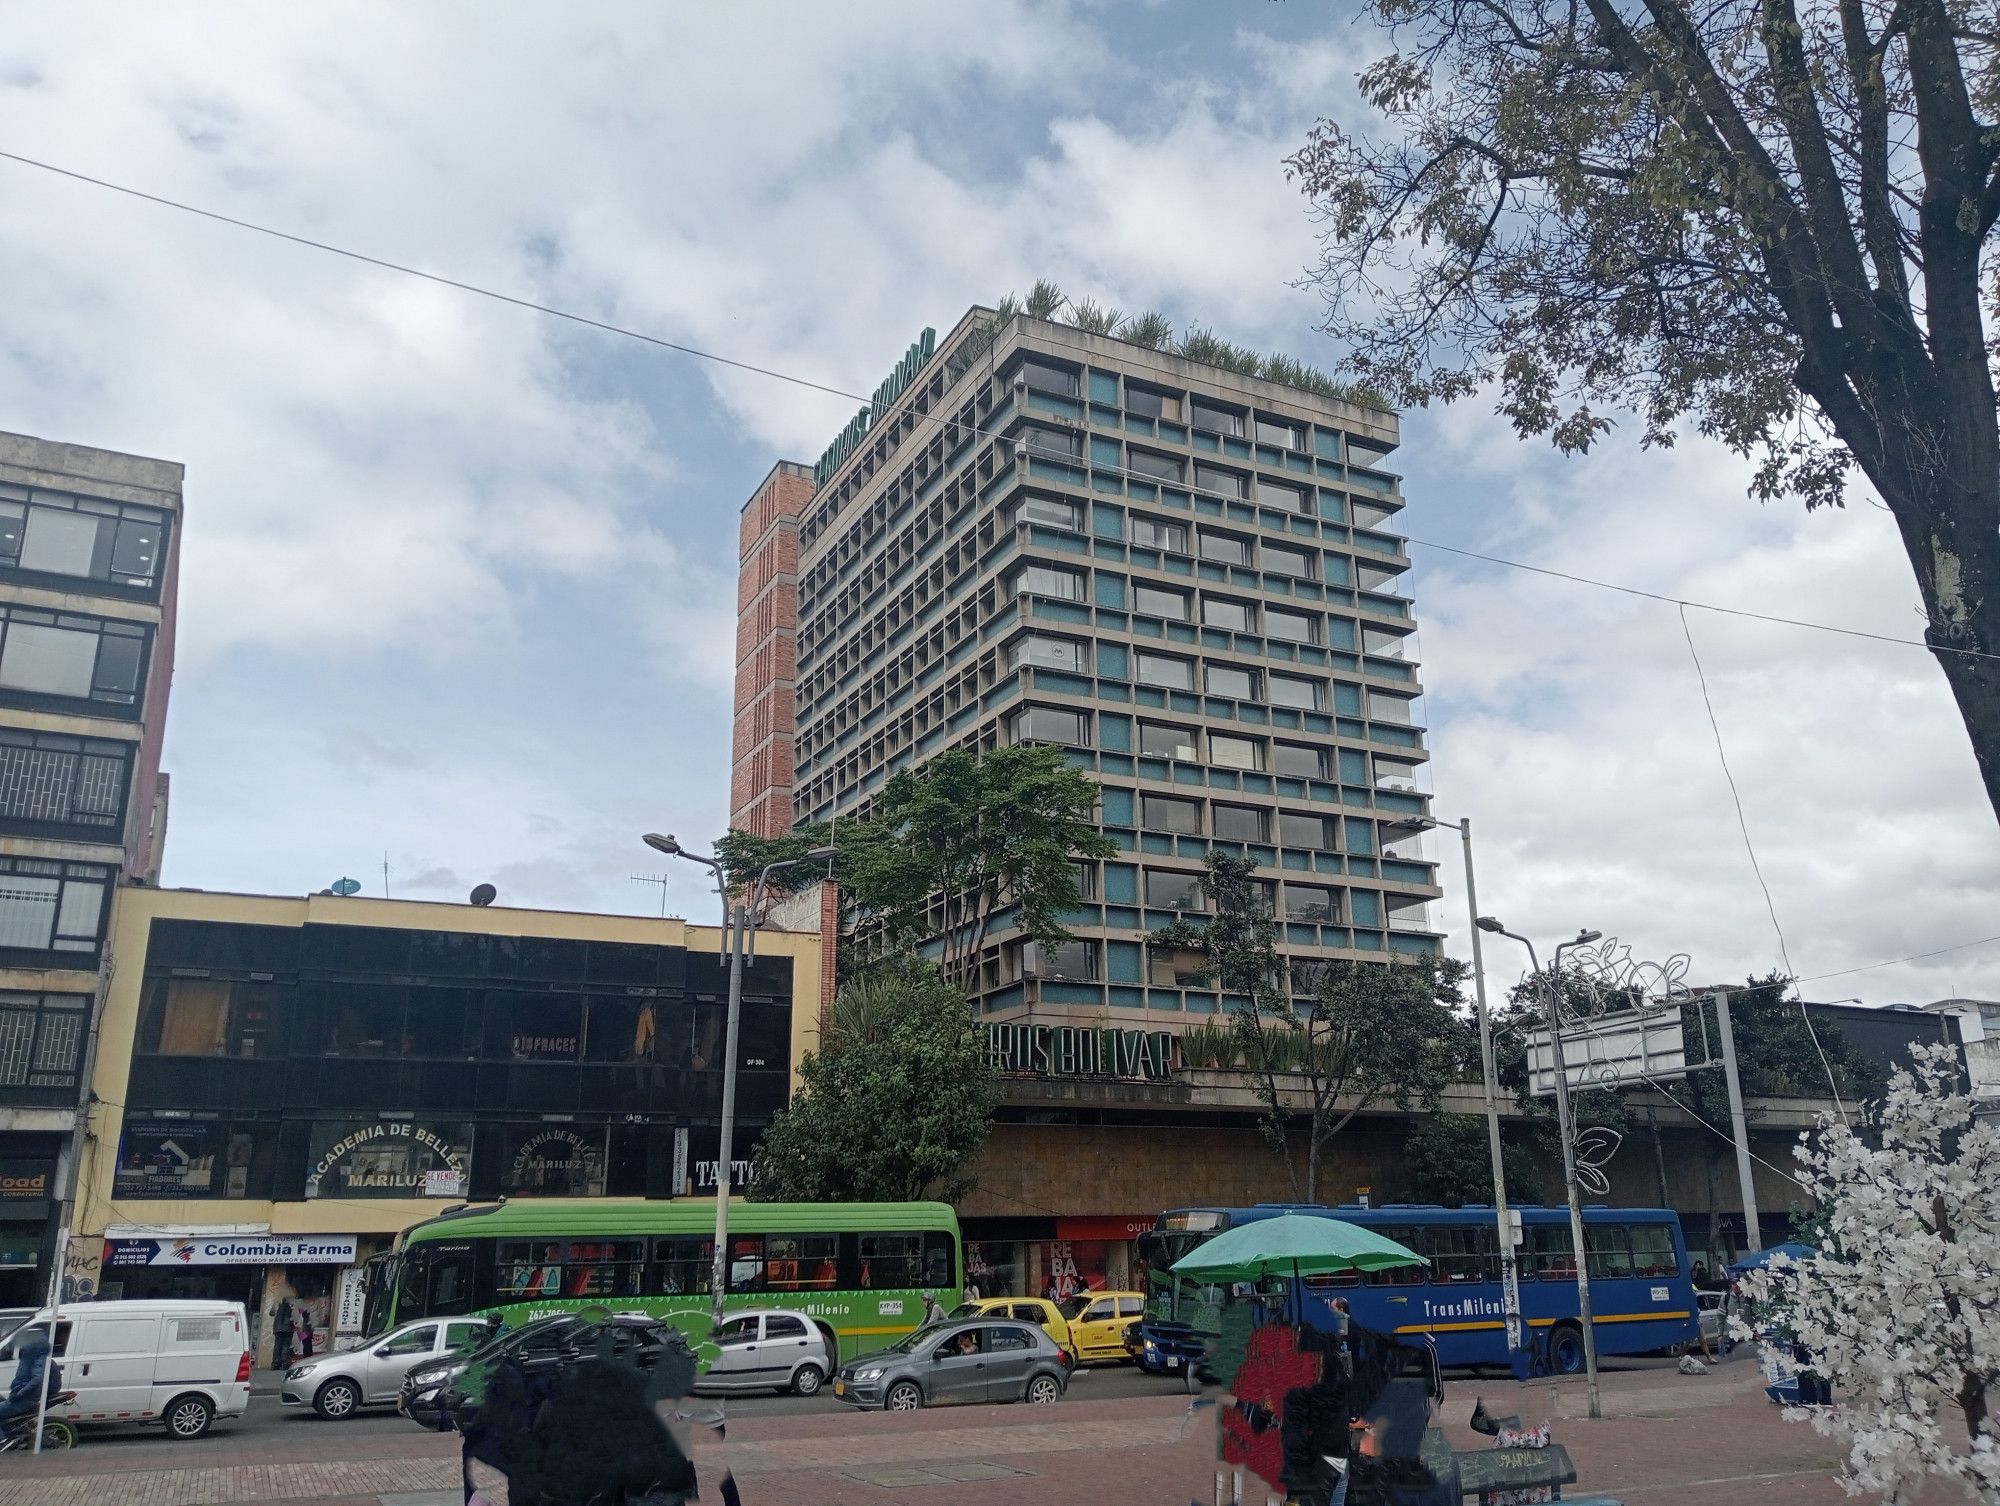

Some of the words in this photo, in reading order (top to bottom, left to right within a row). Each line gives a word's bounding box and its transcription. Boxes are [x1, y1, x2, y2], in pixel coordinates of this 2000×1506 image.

[1056, 1026, 1172, 1080] BOLIVAR
[310, 1125, 385, 1185] ACADEMIA
[389, 1123, 412, 1137] DE
[415, 1128, 469, 1183] BELLEZA
[528, 1160, 582, 1169] MARILUZ
[0, 1174, 46, 1188] oad
[347, 1174, 427, 1187] MARILUZ
[204, 1243, 292, 1256] Colombia
[297, 1243, 352, 1255] Farma
[968, 1243, 980, 1253] RE
[1050, 1241, 1072, 1258] RE
[968, 1253, 982, 1263] BA
[968, 1262, 987, 1273] JAS
[1051, 1258, 1078, 1277] BA
[1423, 1297, 1505, 1318] TransMileni
